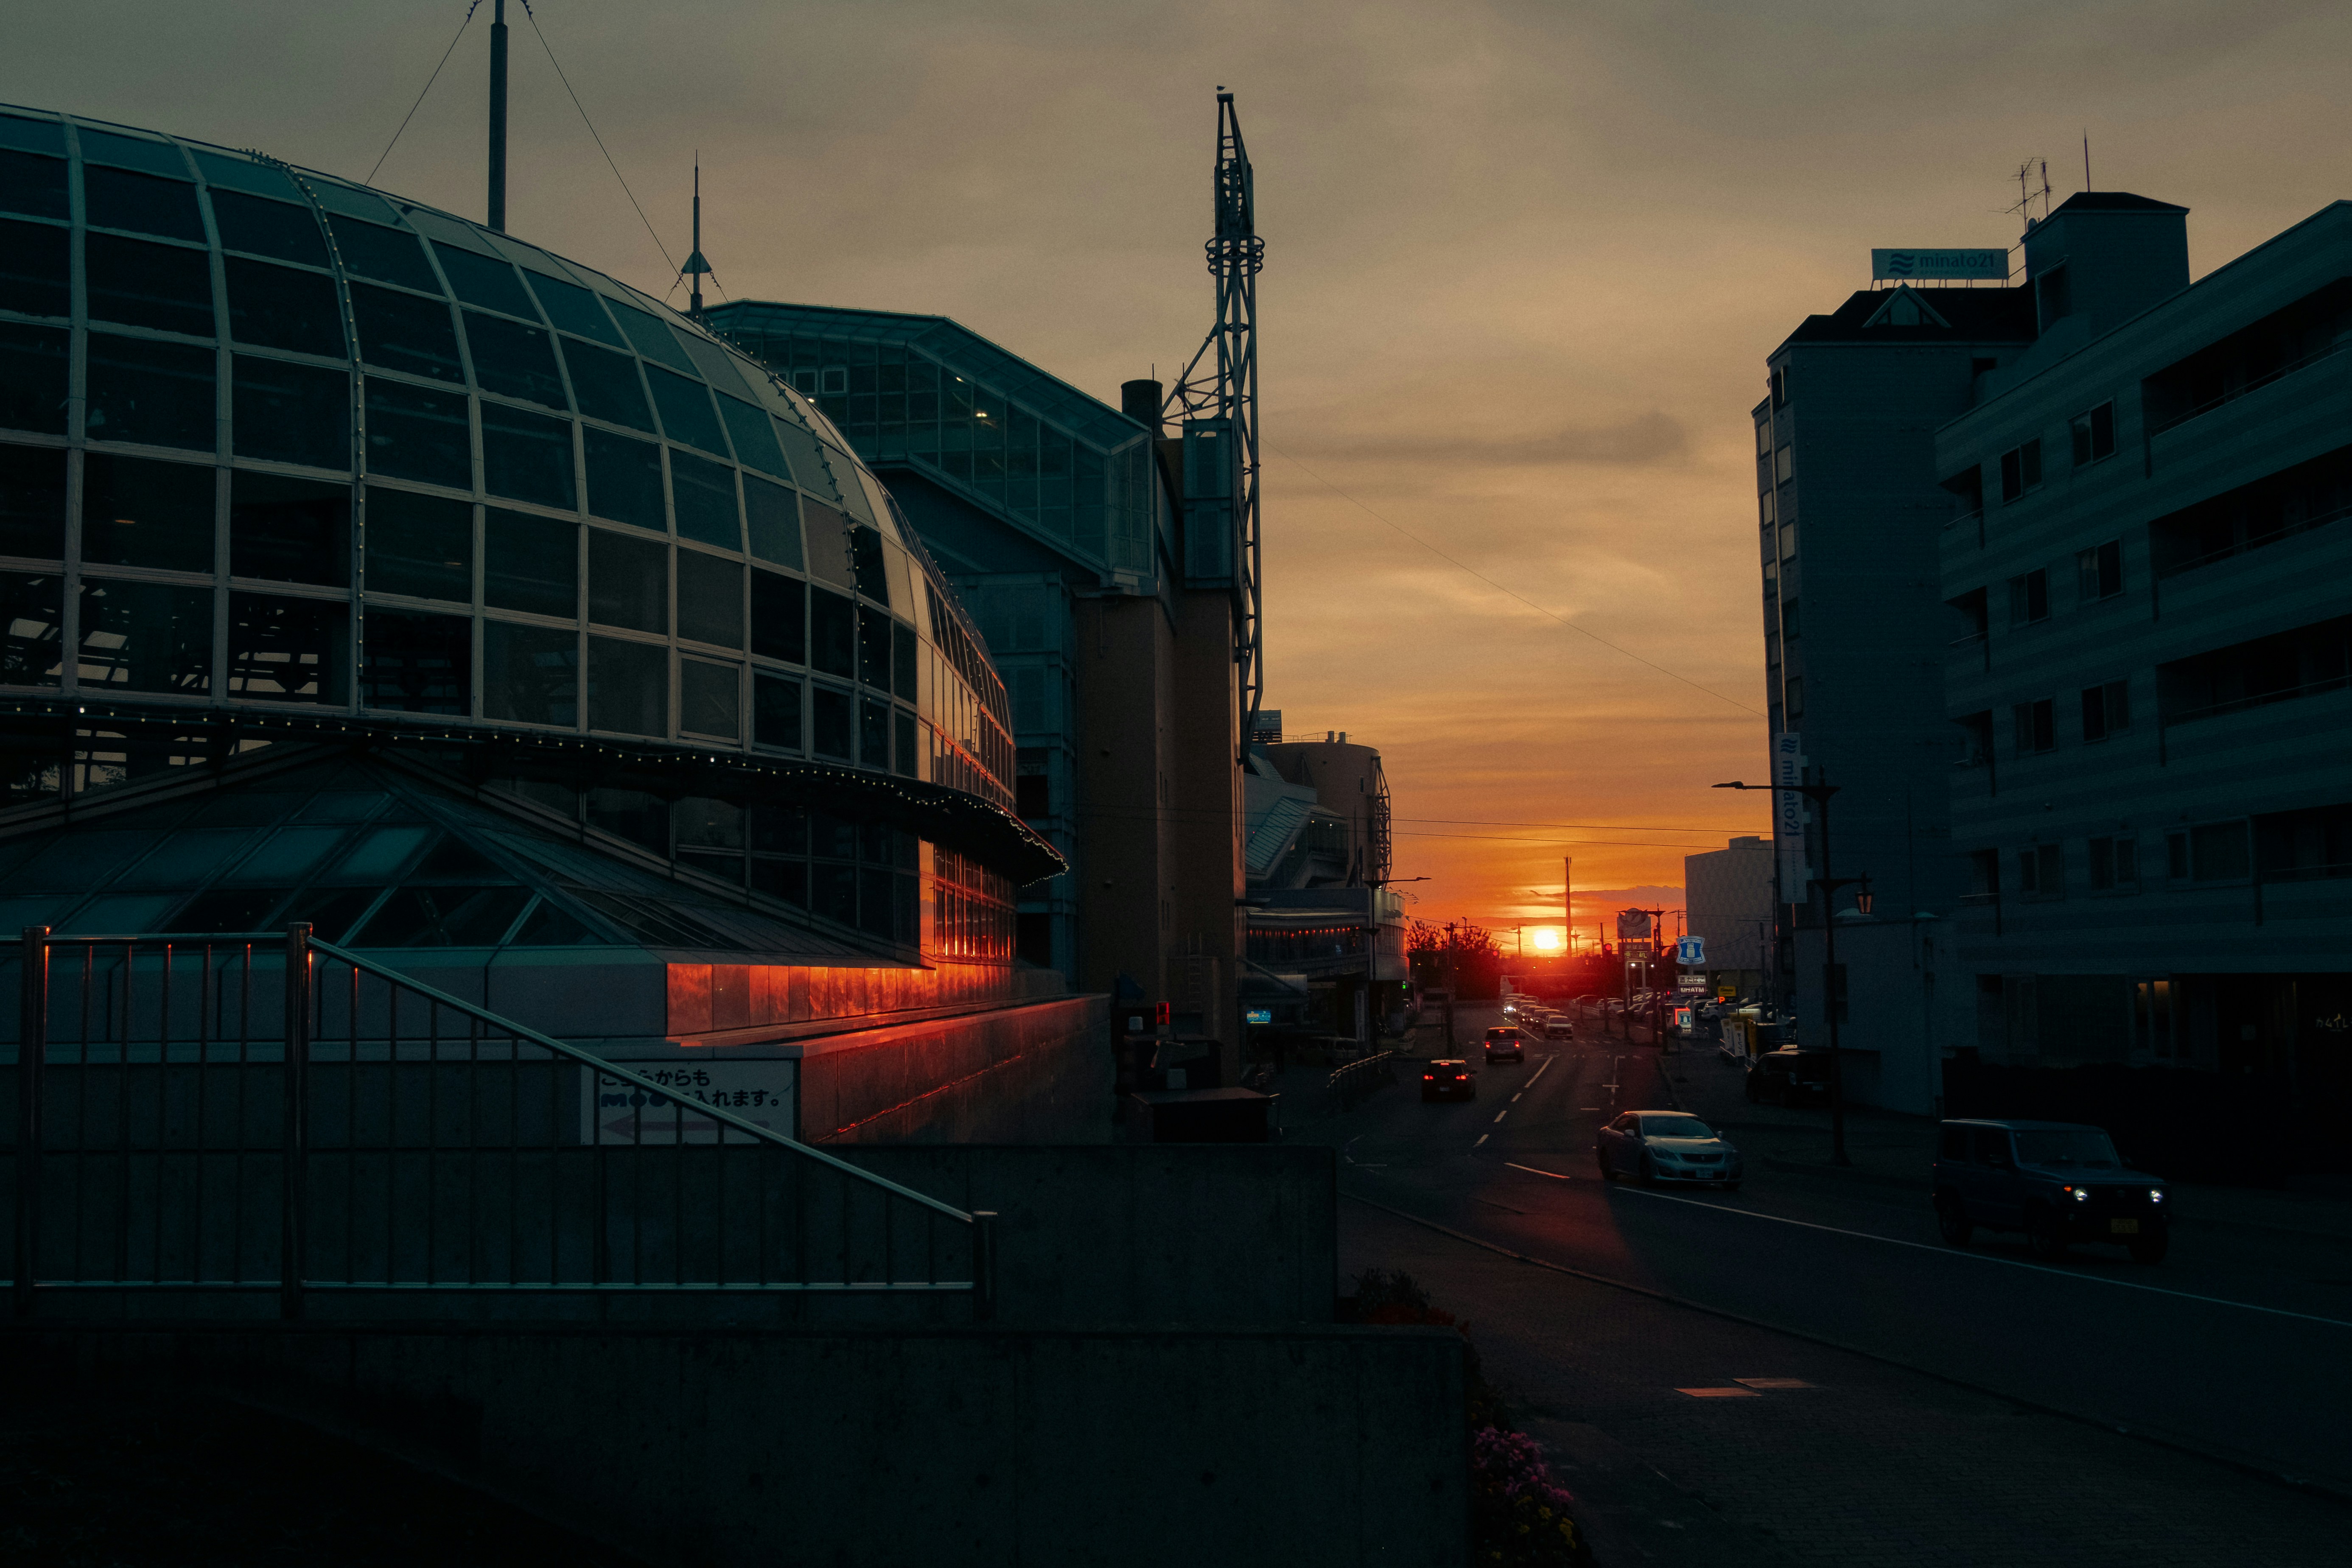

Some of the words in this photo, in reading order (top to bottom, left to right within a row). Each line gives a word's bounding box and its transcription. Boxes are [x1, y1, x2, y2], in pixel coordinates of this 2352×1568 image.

[1920, 253, 1994, 267] minato21
[1719, 996, 1725, 1004] P
[2316, 1013, 2352, 1028] カムイレ
[602, 1069, 710, 1086] こらからも
